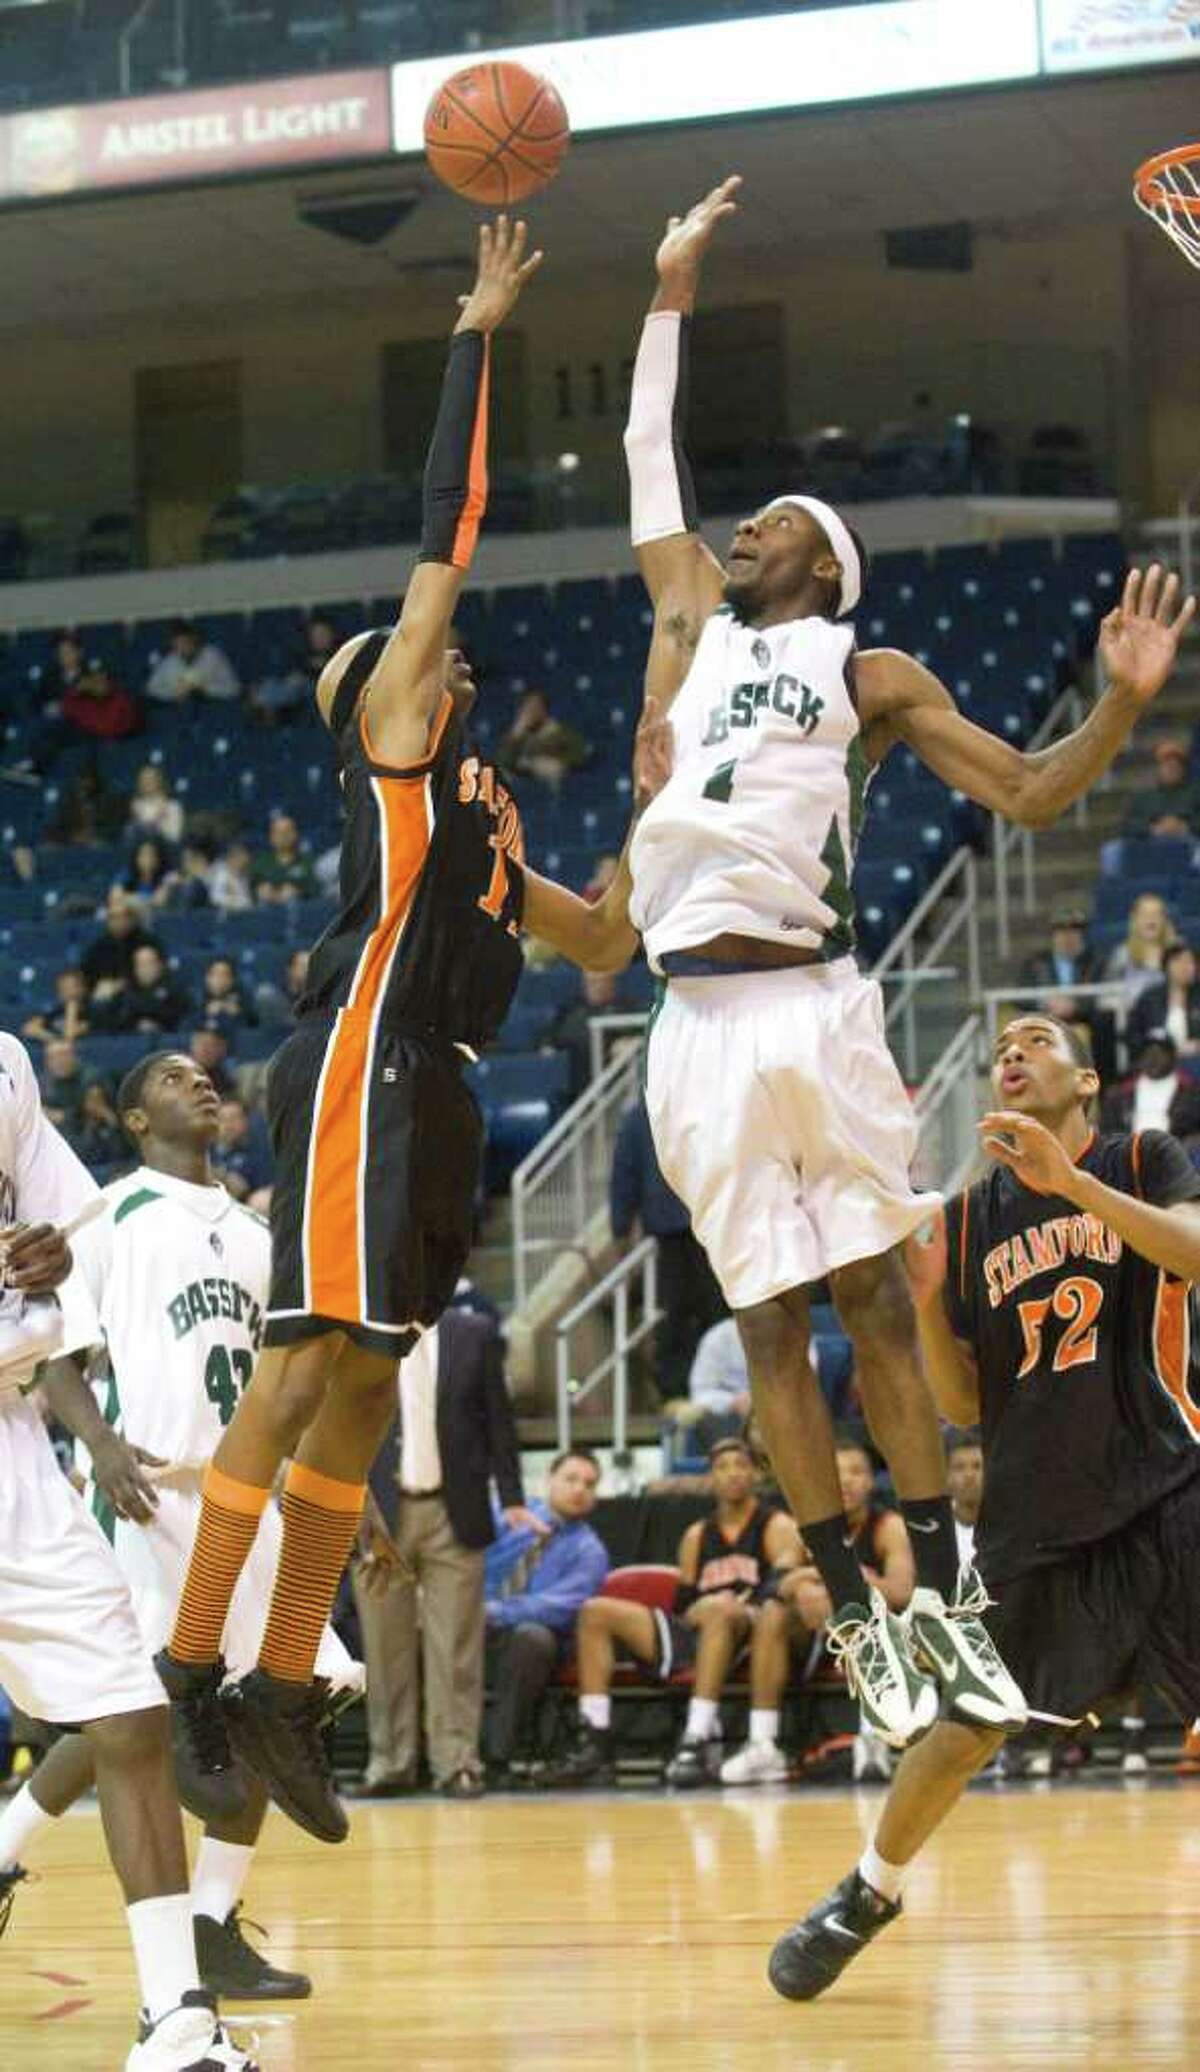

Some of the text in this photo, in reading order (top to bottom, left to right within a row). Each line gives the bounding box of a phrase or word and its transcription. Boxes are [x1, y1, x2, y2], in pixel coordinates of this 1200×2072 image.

[101, 97, 369, 157] AMSTEL LIGHT
[983, 1212, 1123, 1310] STAMFORD
[1016, 1276, 1104, 1379] 52
